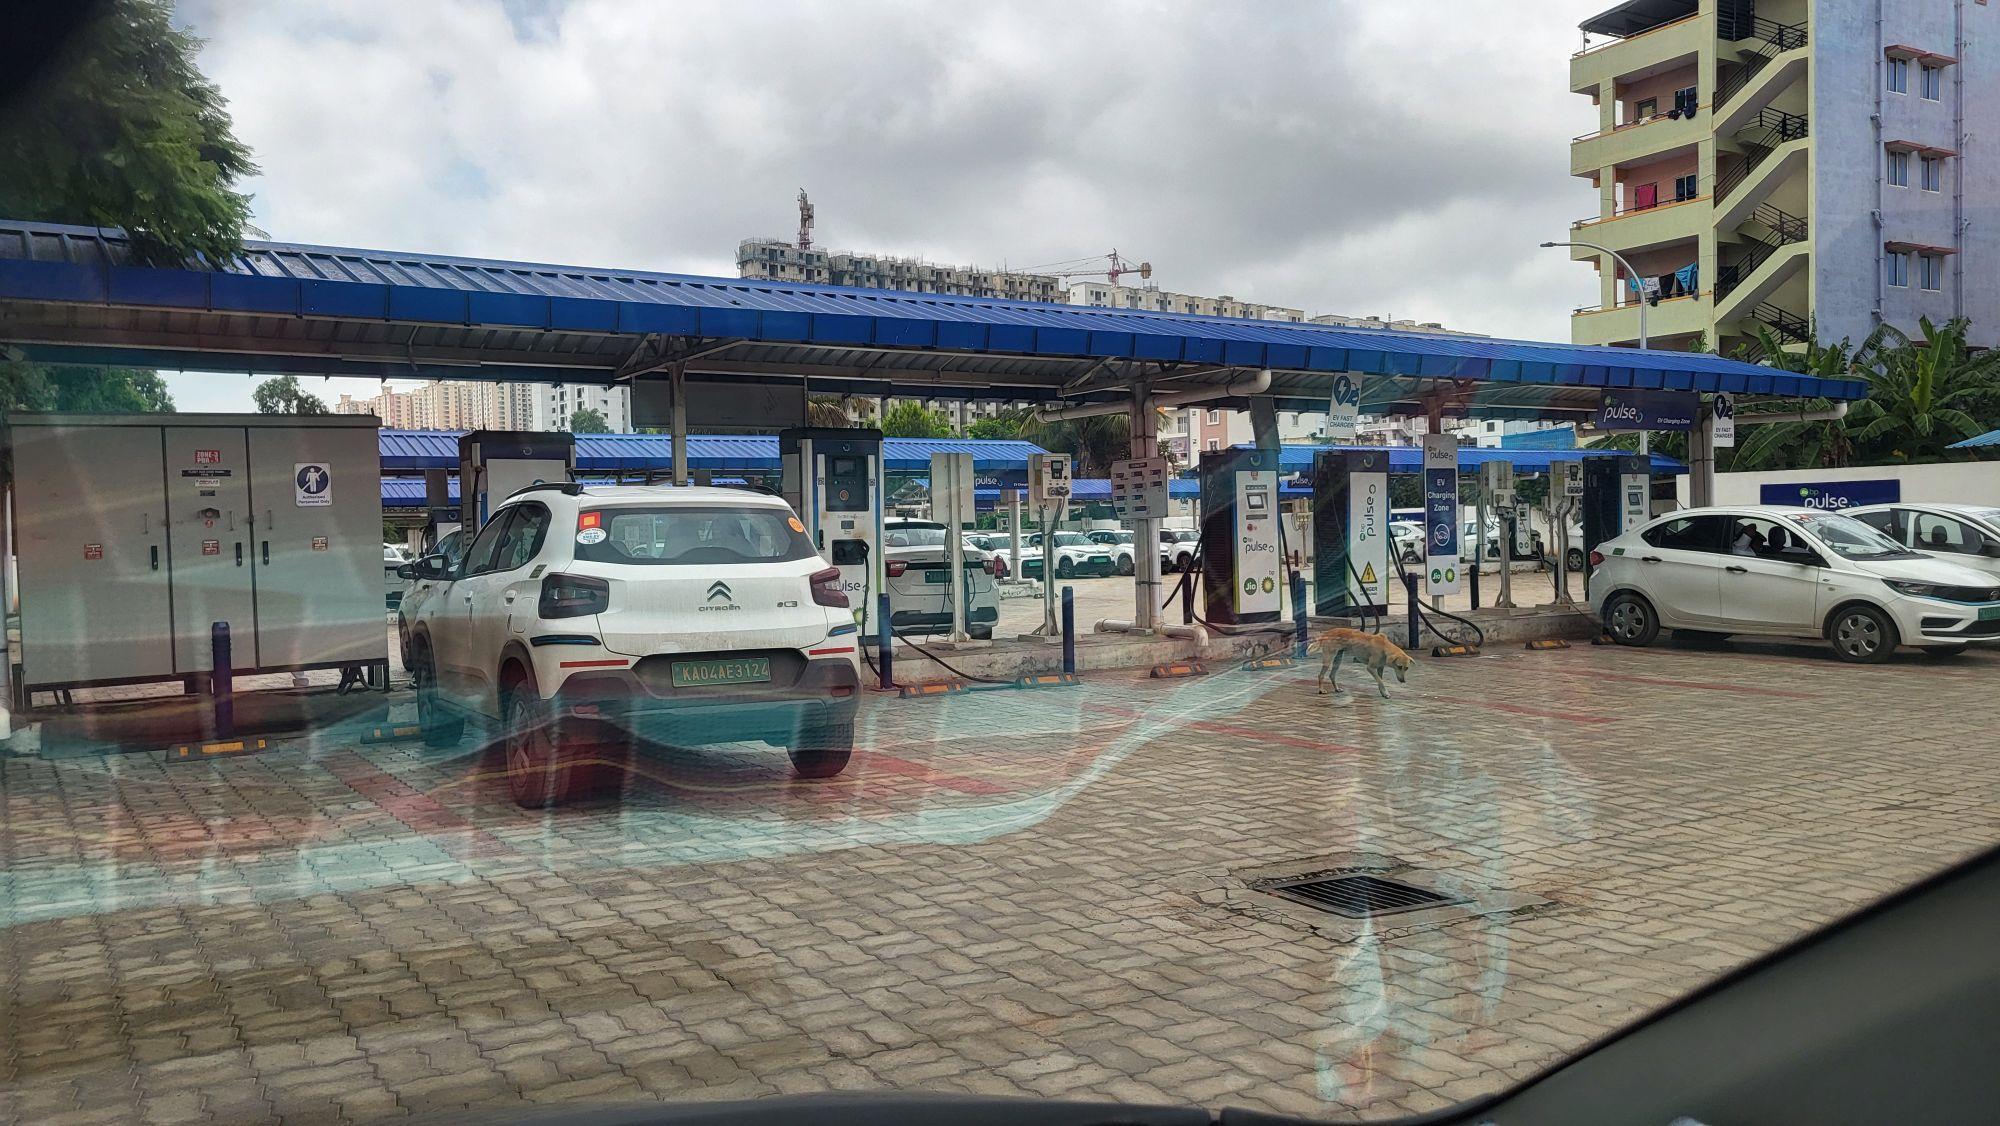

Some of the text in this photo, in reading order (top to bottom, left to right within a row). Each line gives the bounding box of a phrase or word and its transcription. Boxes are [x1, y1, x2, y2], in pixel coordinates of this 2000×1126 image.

[1604, 402, 1637, 422] pulse
[1430, 450, 1449, 461] pulse
[975, 475, 998, 487] pulse
[1437, 478, 1446, 486] EV
[1428, 491, 1456, 501] Charging
[1809, 488, 1819, 497] bp
[1804, 493, 1848, 508] pulse
[1434, 504, 1450, 512] Zone
[1364, 496, 1377, 537] pulse
[1246, 541, 1268, 554] pulse
[839, 579, 861, 592] ulse
[1245, 580, 1257, 591] Jio
[682, 662, 769, 682] KA04AE3124
